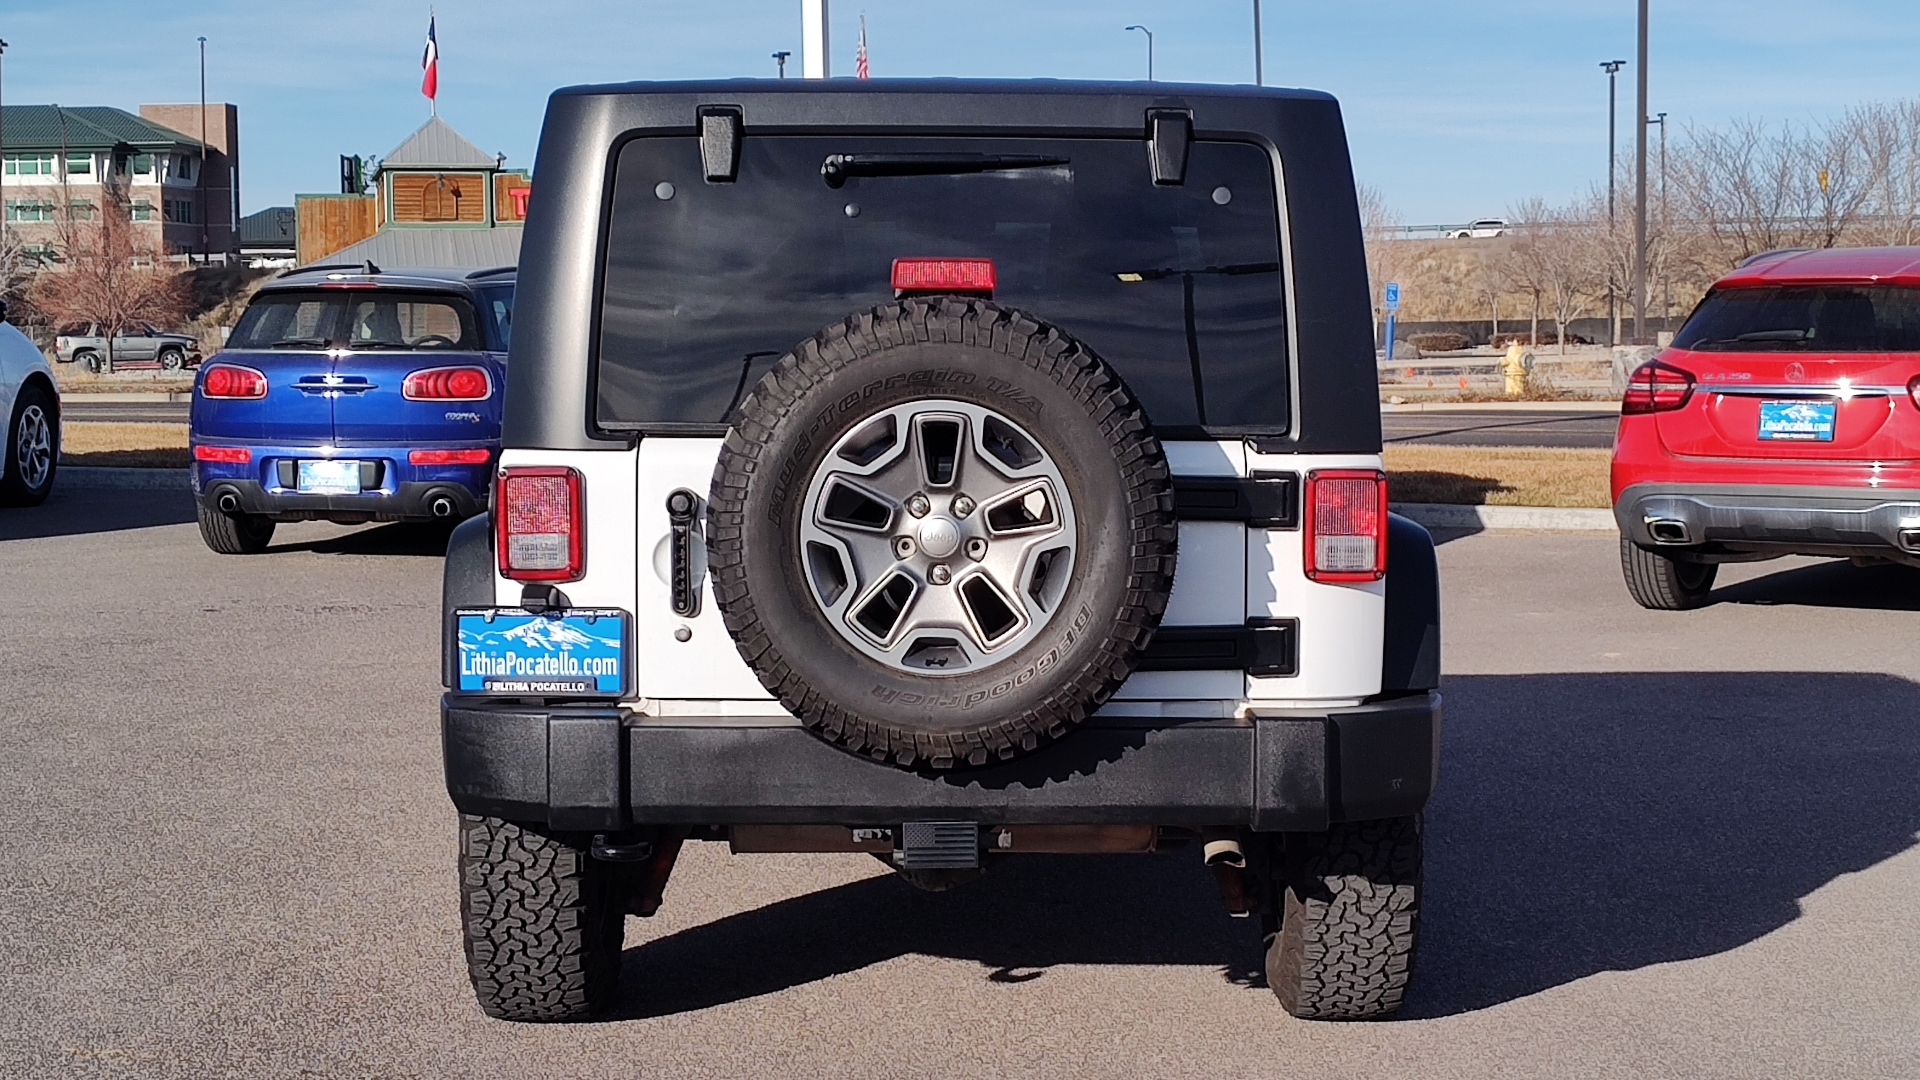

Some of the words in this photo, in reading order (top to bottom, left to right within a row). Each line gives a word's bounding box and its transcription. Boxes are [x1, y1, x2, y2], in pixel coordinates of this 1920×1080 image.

[461, 651, 618, 676] LithiaPocatello.com
[872, 602, 1093, 710] BFGoodrich
[500, 682, 530, 692] LITHIA
[530, 682, 585, 692] POCATELLO
